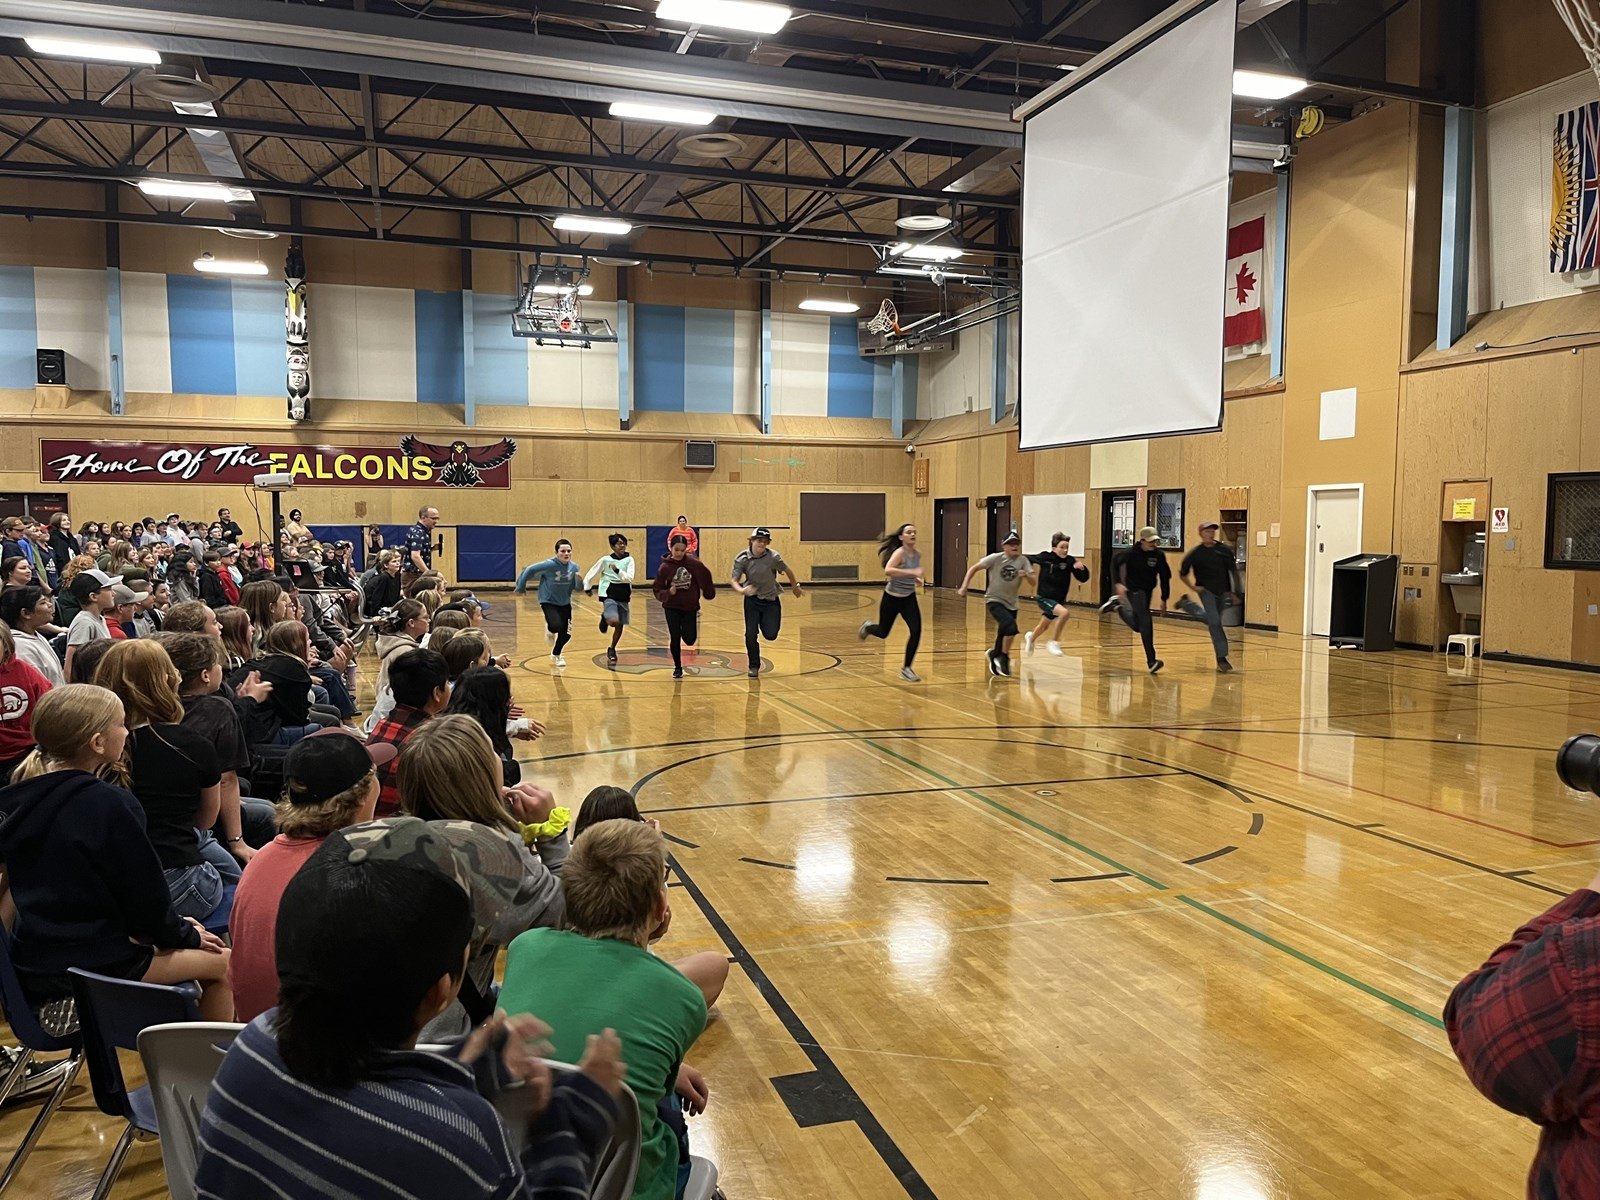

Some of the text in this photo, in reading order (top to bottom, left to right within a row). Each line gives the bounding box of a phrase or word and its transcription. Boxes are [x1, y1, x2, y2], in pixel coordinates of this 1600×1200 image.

[47, 444, 433, 481] Home Of The FALCONS
